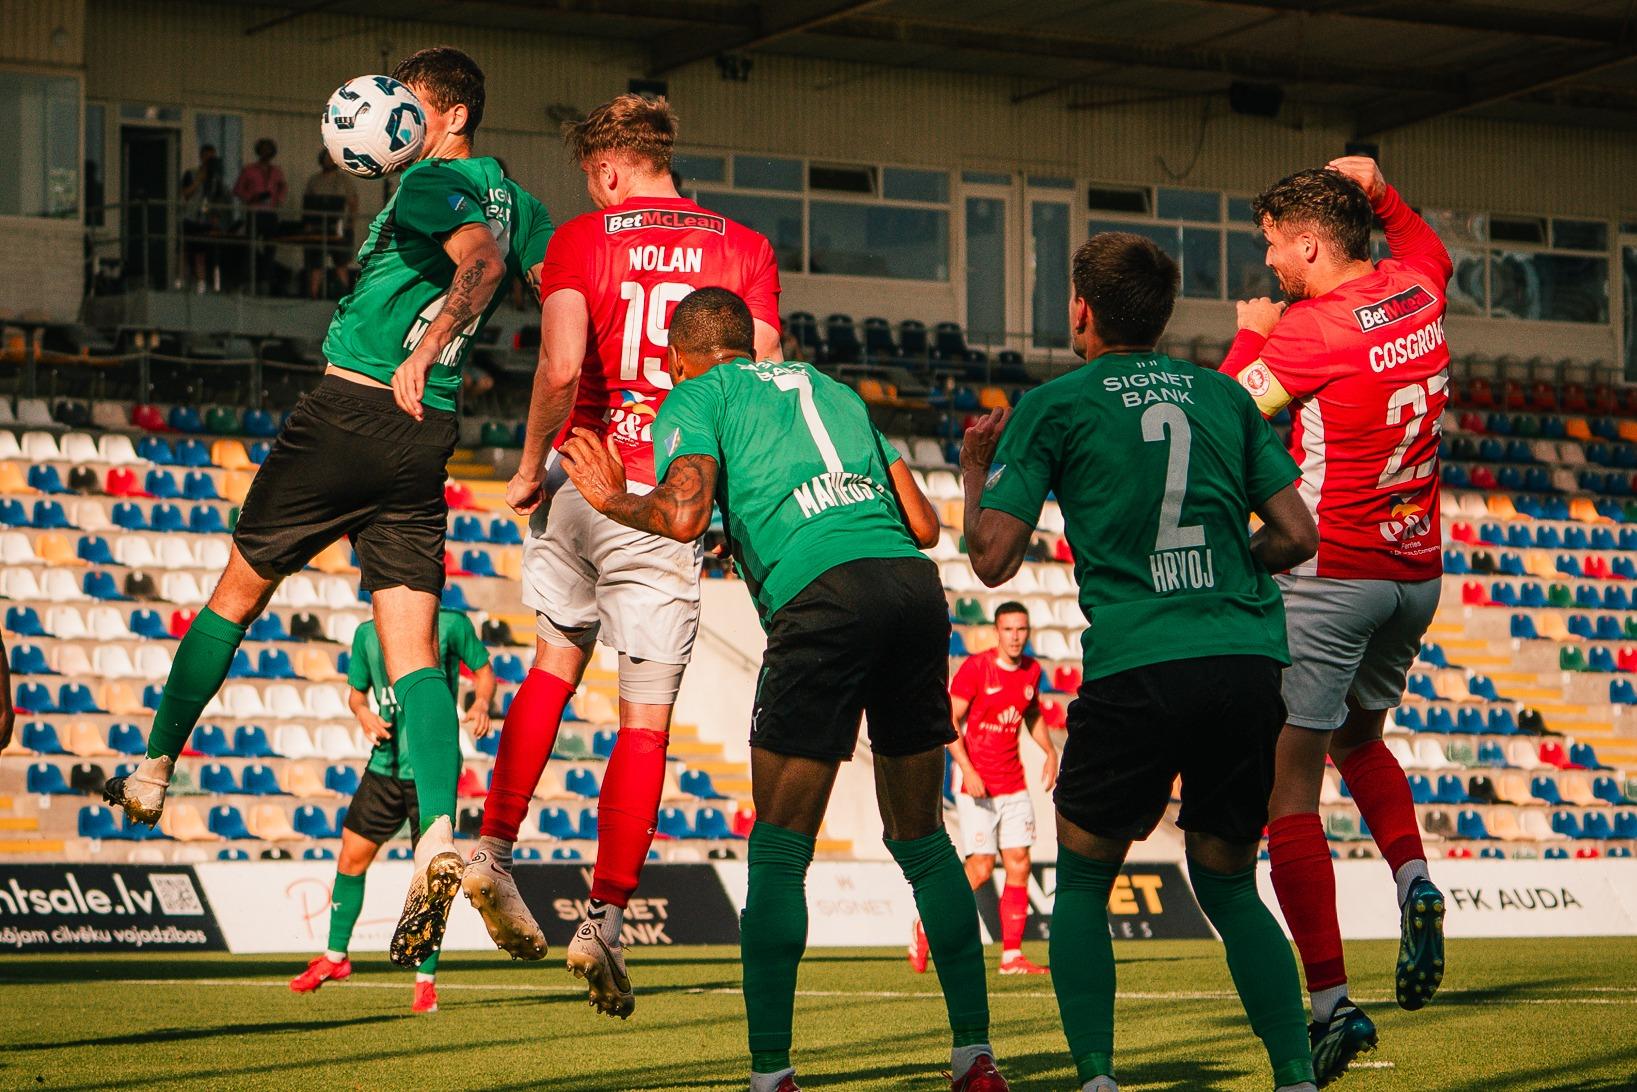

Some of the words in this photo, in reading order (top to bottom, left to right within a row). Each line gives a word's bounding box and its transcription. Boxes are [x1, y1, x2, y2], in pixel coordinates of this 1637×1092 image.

[609, 211, 722, 232] BetMcLean
[629, 245, 703, 273] NOLAN
[1369, 315, 1446, 373] COSGROV
[1103, 371, 1194, 392] SIGNET
[1121, 387, 1194, 408] BANK
[772, 374, 844, 473] 7
[1141, 402, 1206, 551] 2
[793, 472, 876, 519] MATHEUS
[1149, 548, 1215, 593] HRVOJ
[553, 898, 669, 920] SIET
[1107, 874, 1163, 915] ET
[1450, 888, 1493, 911] FK
[1498, 888, 1583, 910] AUDA
